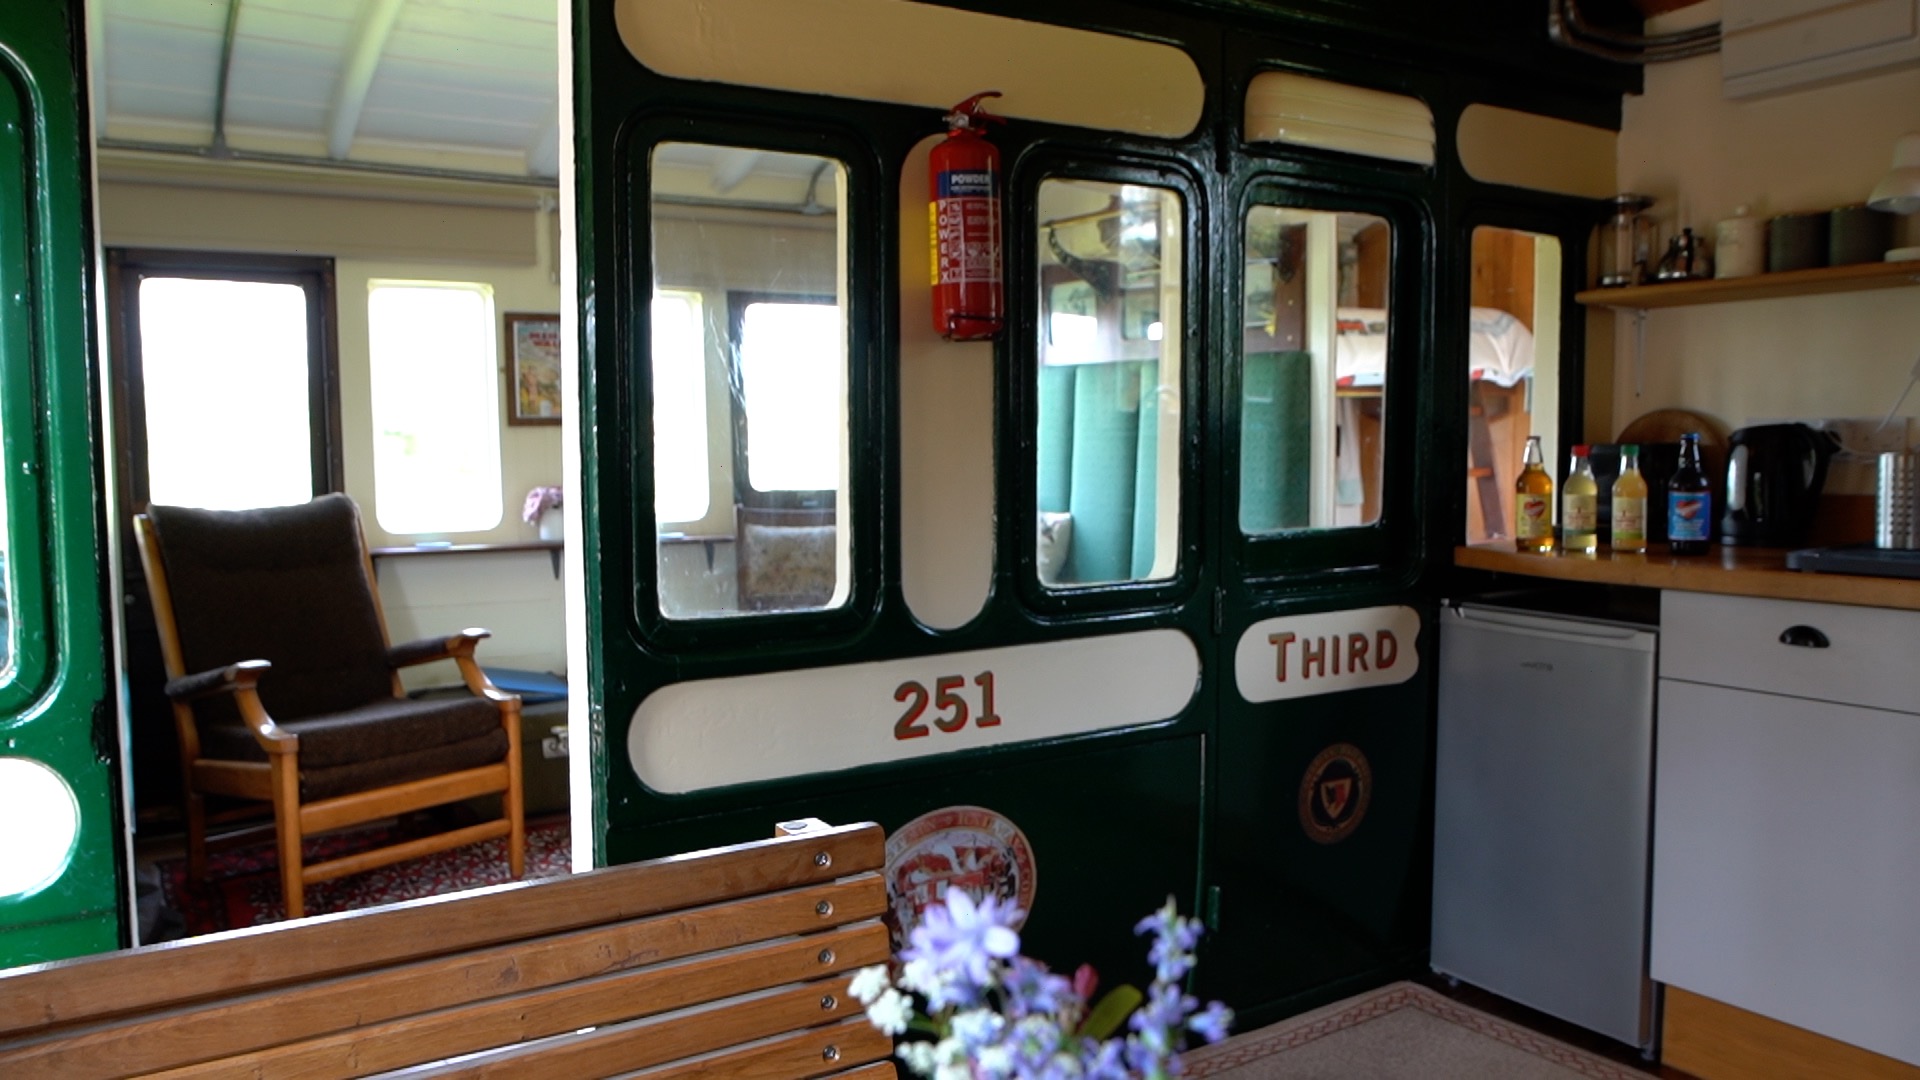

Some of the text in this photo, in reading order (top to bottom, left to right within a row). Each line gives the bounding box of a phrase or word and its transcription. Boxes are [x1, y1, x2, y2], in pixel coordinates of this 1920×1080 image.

[951, 174, 991, 185] POWDER
[1268, 629, 1399, 683] THIRD
[893, 669, 1001, 741] 251
